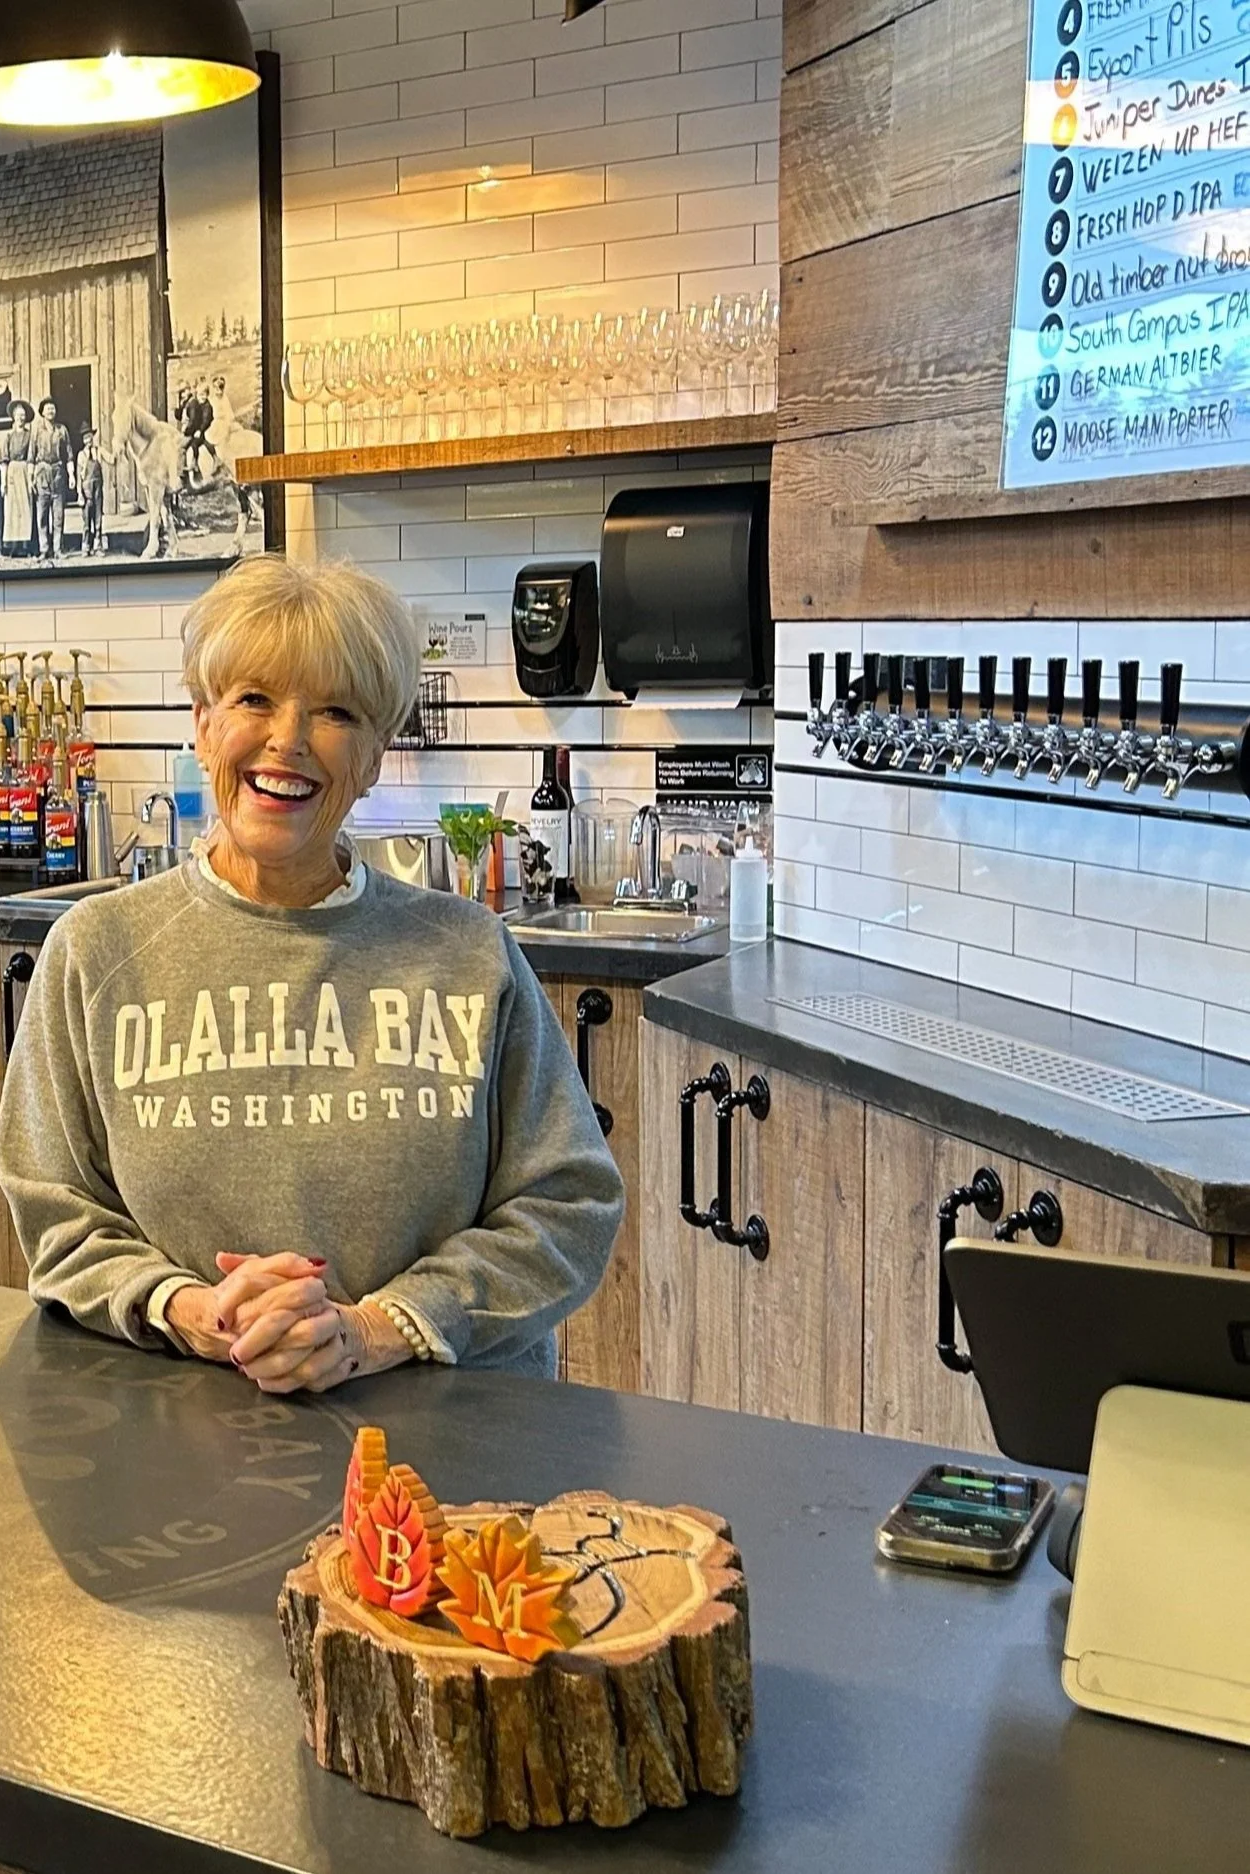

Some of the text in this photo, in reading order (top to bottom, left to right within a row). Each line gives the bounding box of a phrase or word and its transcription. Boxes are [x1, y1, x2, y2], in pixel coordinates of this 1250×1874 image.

[1088, 17, 1158, 93] Export
[1167, 0, 1211, 58] Pils
[1083, 97, 1160, 141] Juniper
[1167, 79, 1226, 111] Dunes
[1082, 138, 1164, 193] WEIZEN
[1175, 125, 1199, 156] UP
[1076, 205, 1127, 249] FRESH
[1132, 194, 1166, 230] HOP
[1071, 270, 1103, 308] Old
[1109, 255, 1169, 297] timber
[1174, 232, 1208, 284] nut
[1065, 311, 1123, 353] South
[1128, 308, 1201, 349] Campus
[1206, 289, 1249, 332] IPA
[1070, 363, 1147, 398] GERMAN
[1150, 344, 1222, 384] ALTBIER
[1063, 417, 1119, 453] MOOSE
[1124, 410, 1162, 442] MAN
[1166, 399, 1230, 440] PORTER
[659, 761, 693, 769] Employees
[703, 770, 734, 778] Returning
[114, 981, 486, 1091] OLALLA BAY
[133, 1084, 475, 1129] WASHINGTON
[374, 1524, 412, 1590] B
[472, 1570, 530, 1639] M
